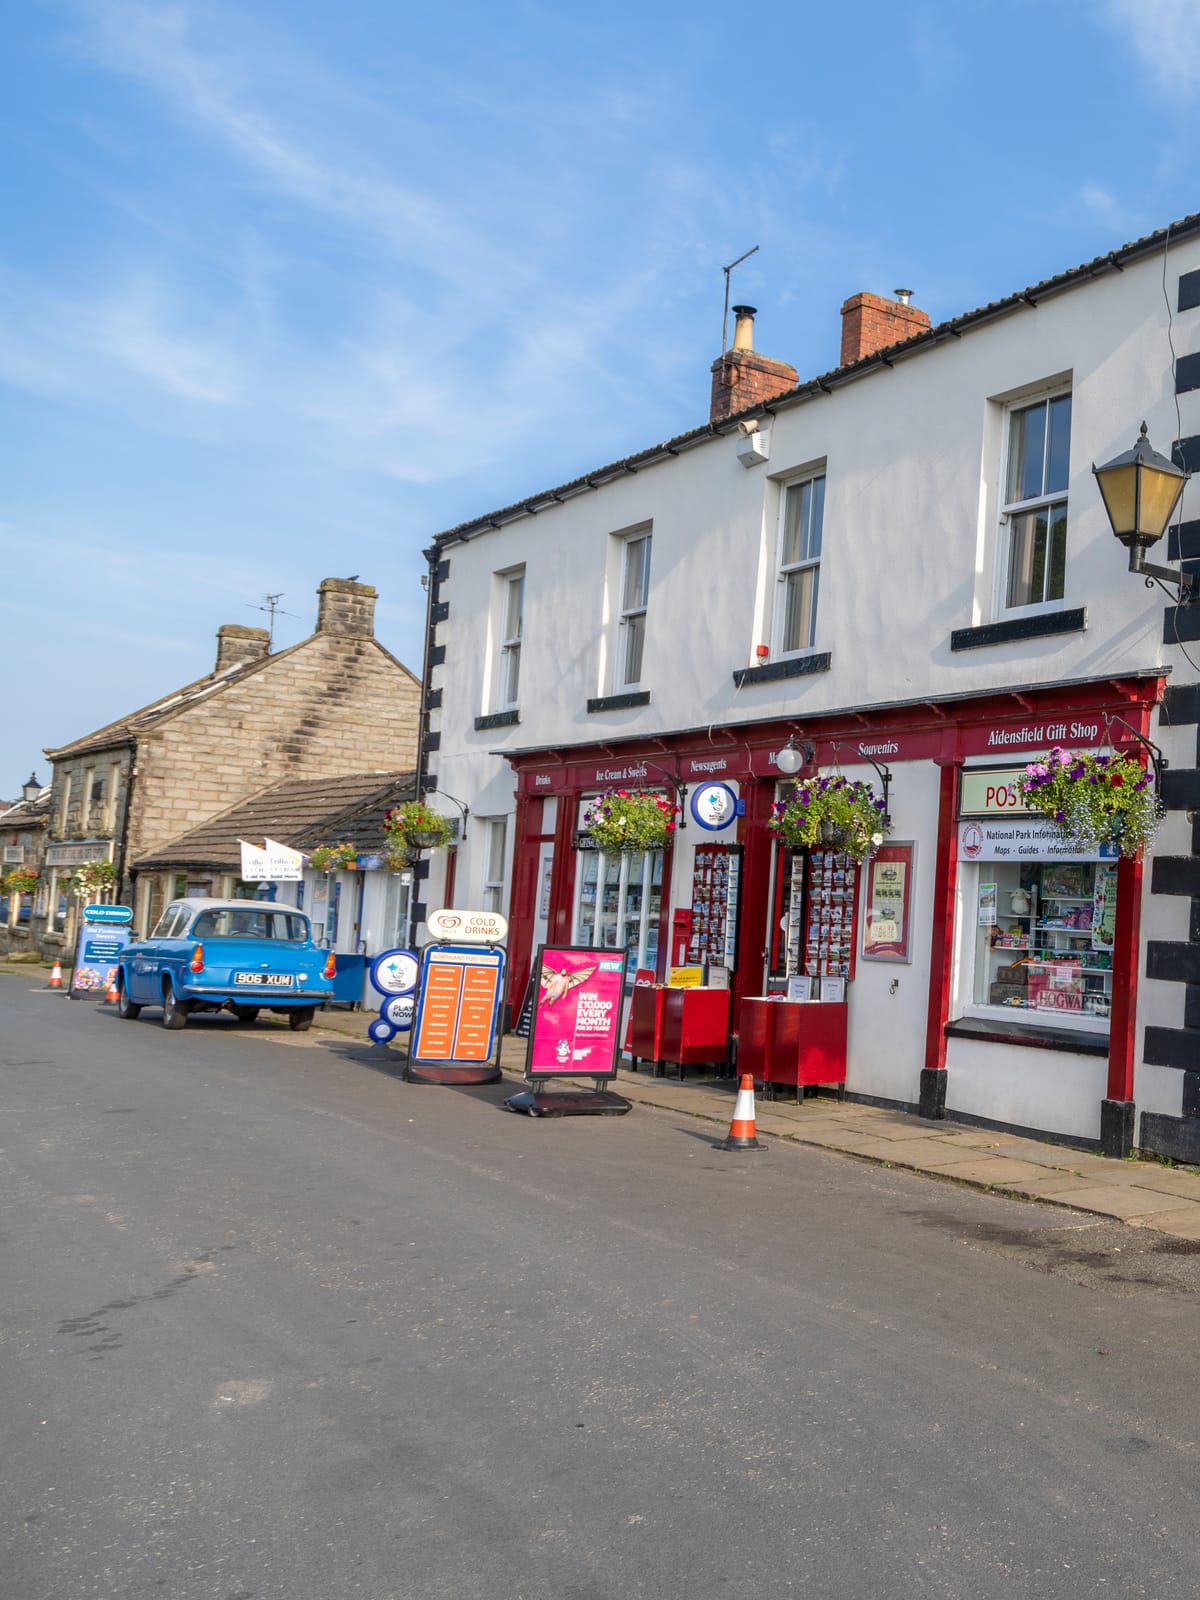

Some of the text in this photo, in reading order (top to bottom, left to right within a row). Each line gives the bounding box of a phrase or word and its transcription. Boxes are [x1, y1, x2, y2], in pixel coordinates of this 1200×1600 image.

[987, 722, 1098, 745] Aidensfield Gift Shop
[858, 740, 899, 756] Souvenirs
[690, 758, 727, 773] Newsagents
[595, 770, 604, 781] Ice
[605, 769, 622, 780] Cream
[535, 775, 551, 785] Drinks
[986, 830, 1015, 840] National
[1015, 830, 1031, 840] Park
[994, 845, 1010, 856] Maps
[1018, 845, 1039, 855] Guides
[469, 917, 496, 926] COLD
[464, 926, 500, 935] DRINKS
[600, 962, 619, 970] NEW
[238, 974, 290, 985] 906 XUM
[579, 992, 598, 1001] WIN
[393, 1004, 414, 1012] PLAY
[392, 1011, 414, 1019] NOW
[577, 1009, 608, 1018] EVERY
[576, 1017, 611, 1026] MONTH
